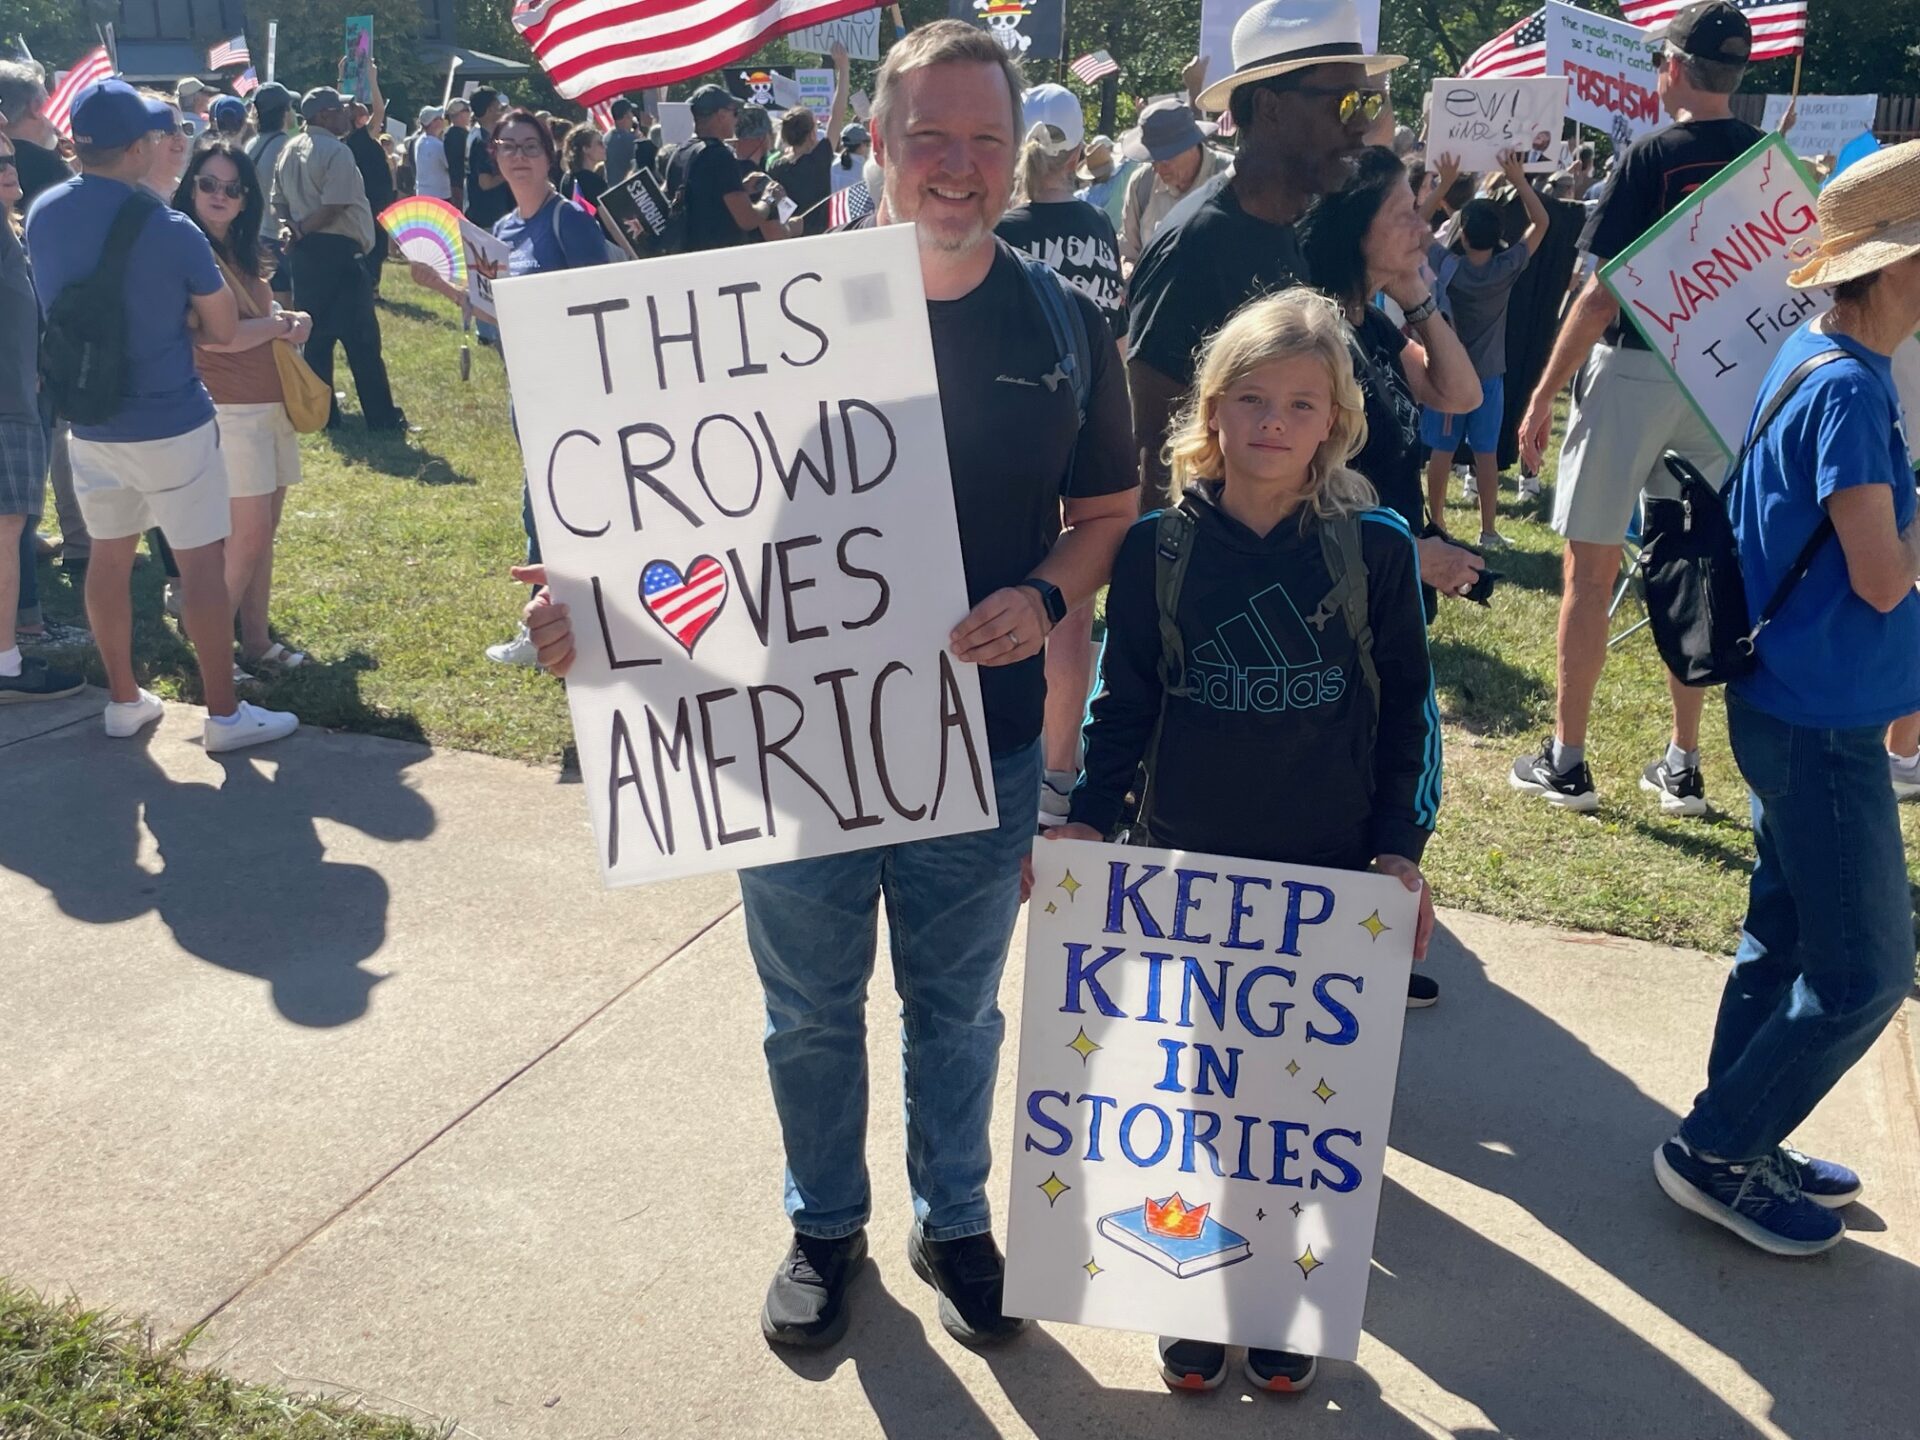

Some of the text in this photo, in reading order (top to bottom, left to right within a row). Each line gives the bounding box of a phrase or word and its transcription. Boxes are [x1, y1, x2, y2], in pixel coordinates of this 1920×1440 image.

[1562, 16, 1578, 31] the
[1582, 23, 1608, 40] mask
[1612, 33, 1641, 53] stays
[1571, 38, 1582, 50] so
[1586, 40, 1592, 53] I
[1596, 44, 1623, 63] don't
[1563, 59, 1660, 126] FASCISM
[626, 180, 667, 236] THRONES
[1632, 191, 1818, 333] WARNING
[567, 272, 829, 394] THIS
[1702, 289, 1830, 378] I FiGH
[547, 398, 897, 538] CROWD
[1186, 665, 1347, 712] adidas
[608, 649, 990, 868] AMERICA
[1102, 861, 1336, 957] KEEP
[1058, 942, 1364, 1046] KINGS
[1153, 1037, 1243, 1099] IN
[1024, 1089, 1362, 1193] STORIES
